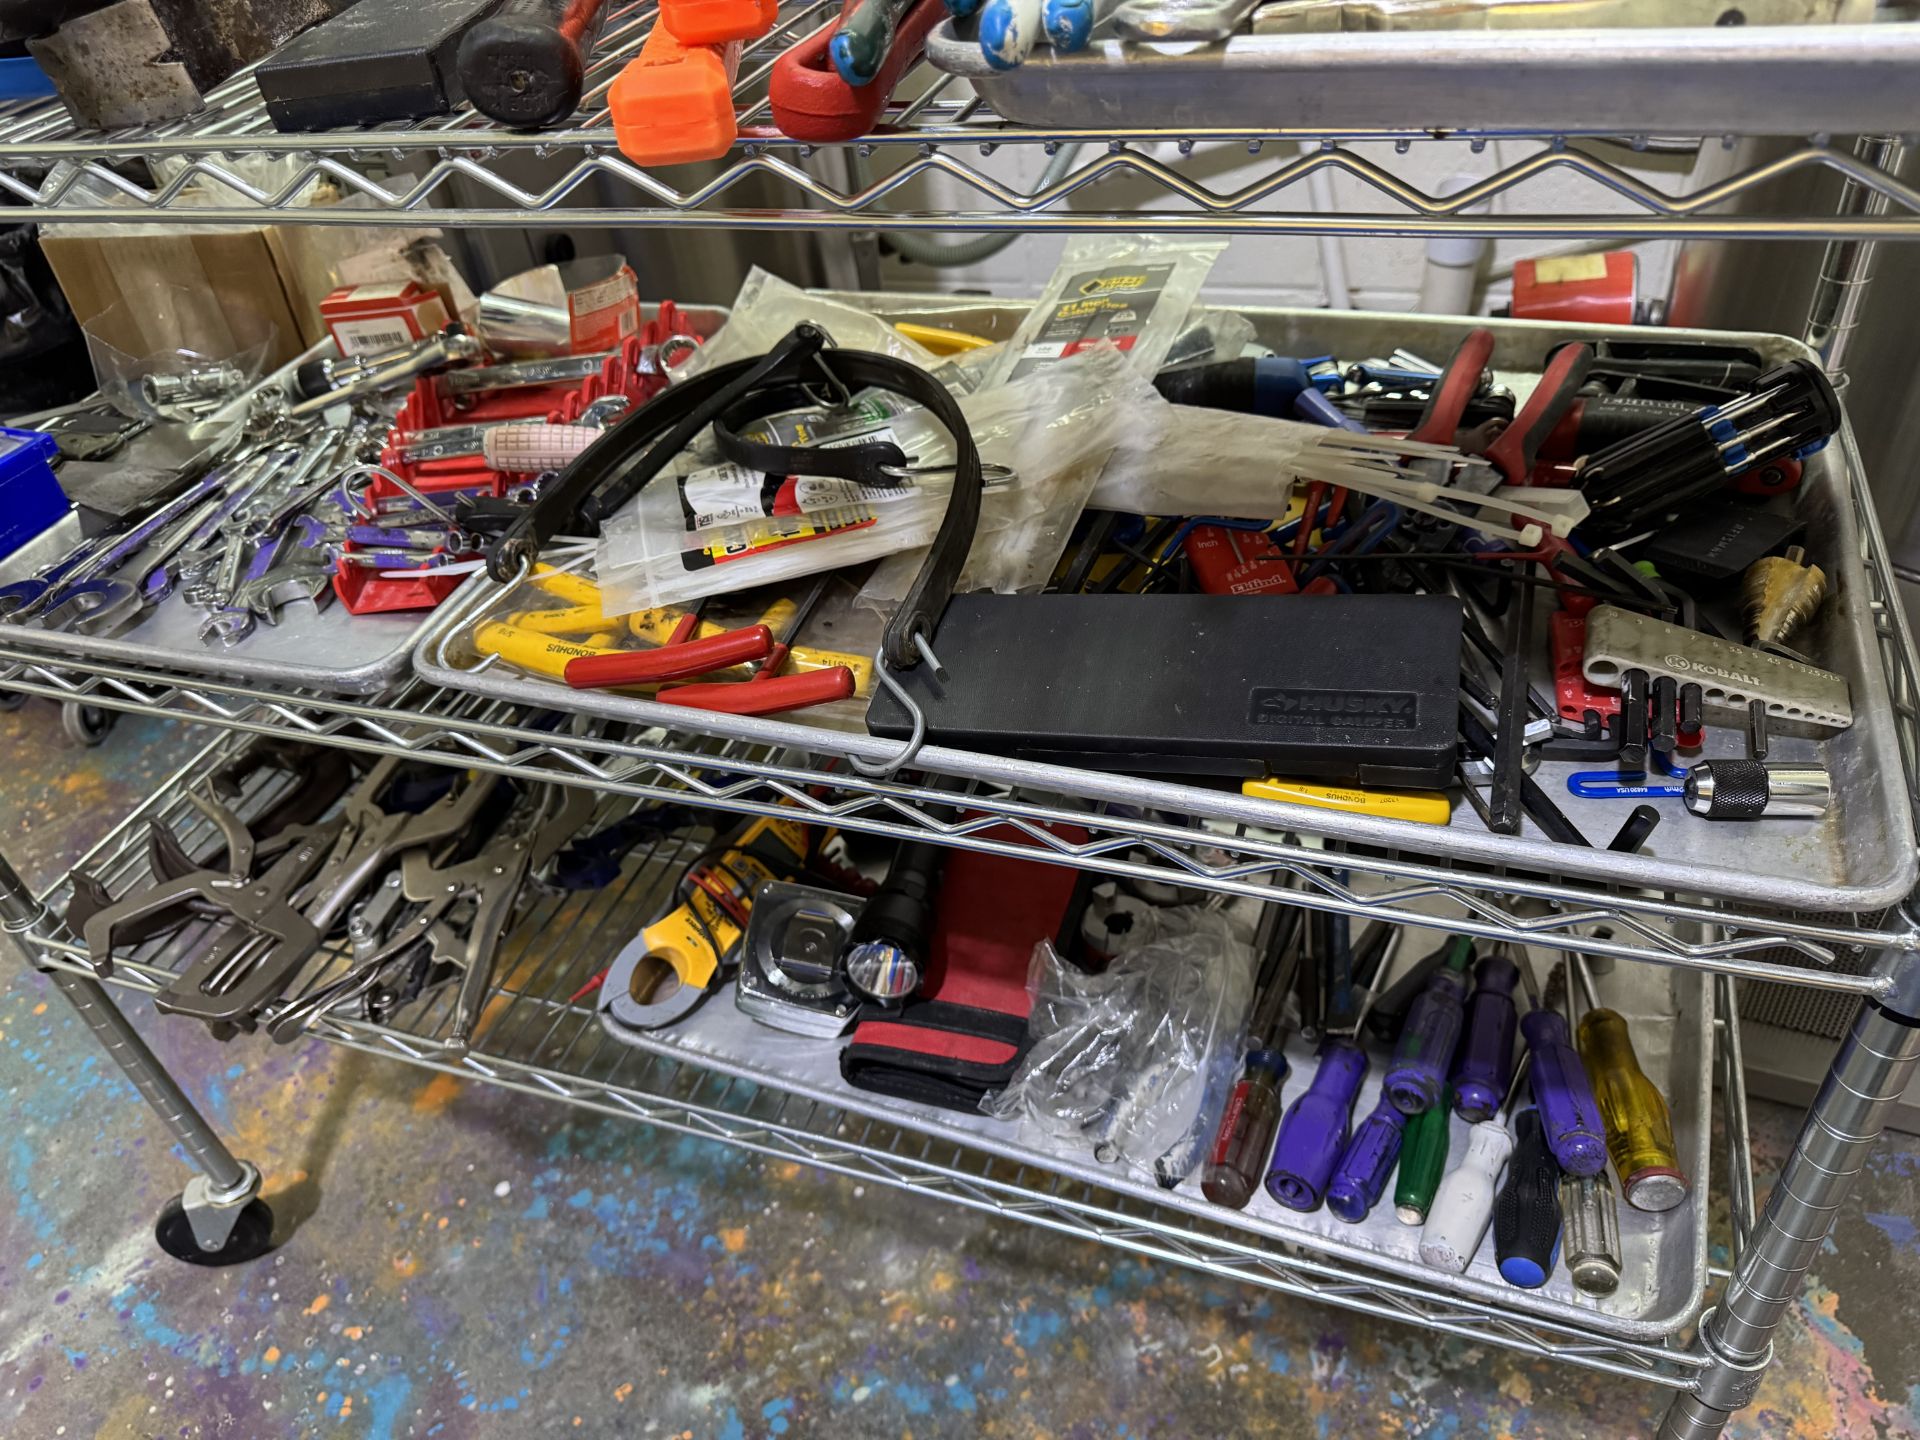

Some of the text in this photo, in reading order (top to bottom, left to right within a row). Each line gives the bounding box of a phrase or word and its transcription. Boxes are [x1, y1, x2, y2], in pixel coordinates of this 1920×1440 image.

[1230, 574, 1283, 595] Eklind
[1692, 662, 1761, 687] KOBALT
[1256, 714, 1325, 725] DIGITAL
[1325, 792, 1366, 804] BONDHUS
